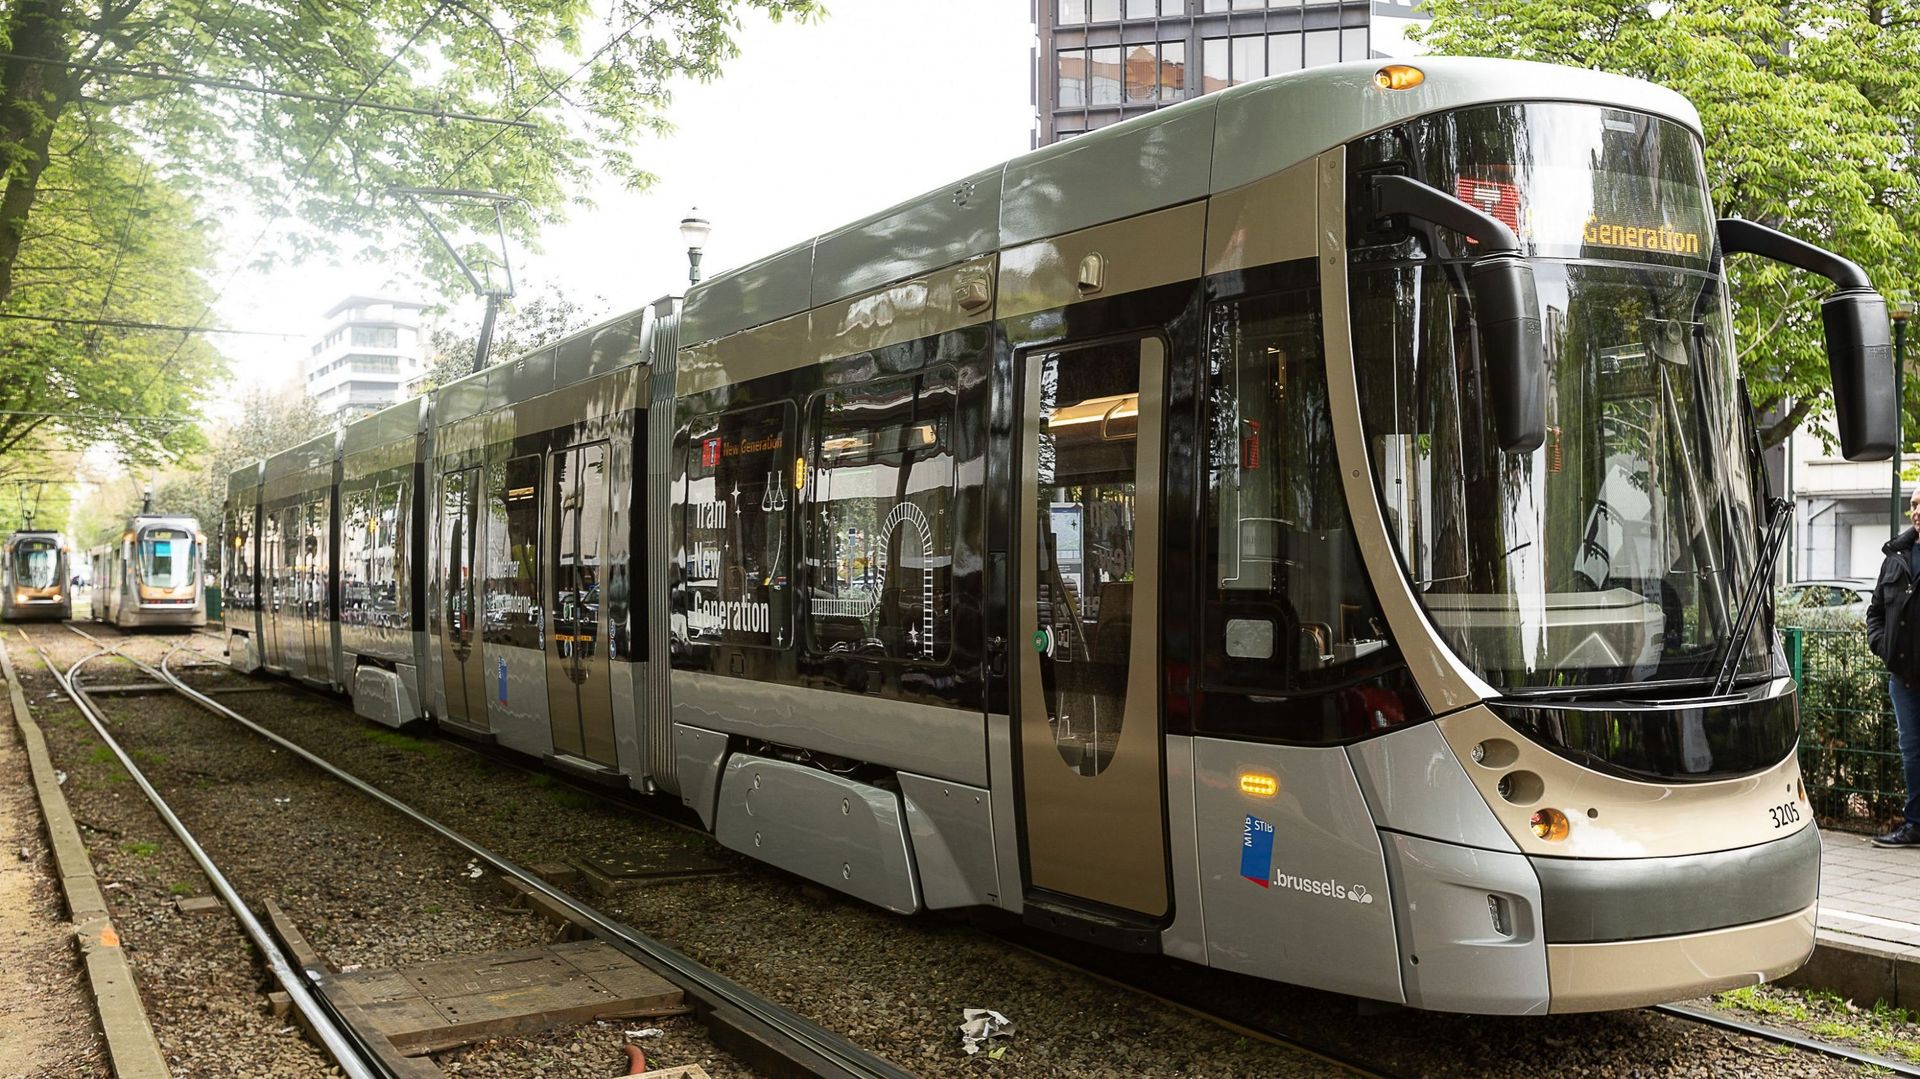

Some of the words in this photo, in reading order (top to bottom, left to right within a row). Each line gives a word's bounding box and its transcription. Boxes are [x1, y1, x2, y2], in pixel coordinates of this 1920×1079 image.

[1583, 214, 1698, 253] Generation
[723, 442, 739, 457] New
[740, 434, 783, 454] Generation
[695, 499, 727, 529] Tram
[694, 541, 721, 579] New
[694, 589, 769, 633] Generation
[1769, 801, 1800, 828] 3205
[1272, 868, 1346, 900] .brussels
